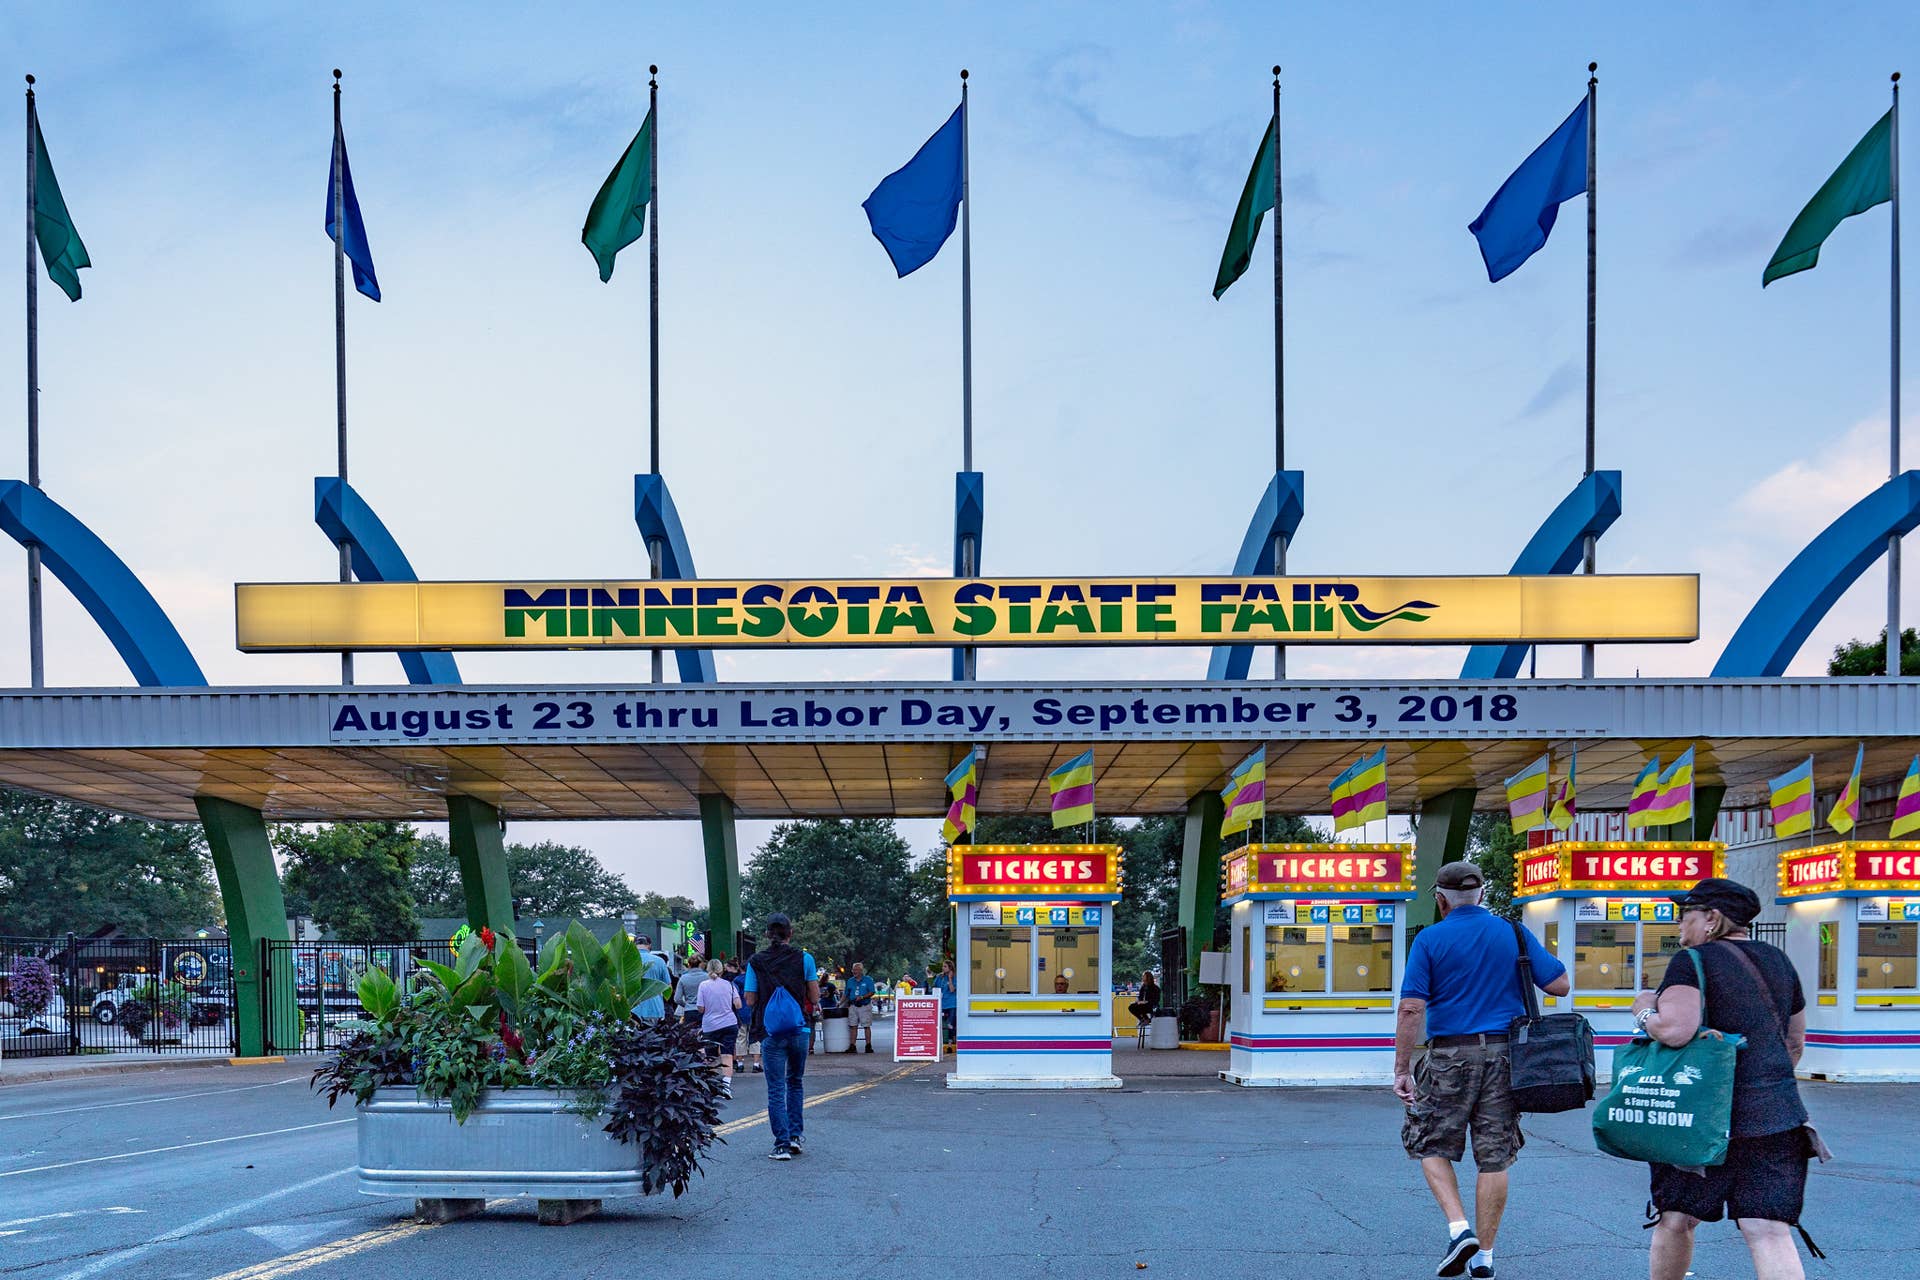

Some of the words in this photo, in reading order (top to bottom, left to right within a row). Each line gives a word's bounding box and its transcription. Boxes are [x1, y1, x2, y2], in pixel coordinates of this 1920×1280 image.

[504, 584, 935, 637] MINNESOTA
[953, 582, 1177, 636] STATE
[1201, 582, 1439, 633] FAIR
[332, 702, 512, 738] August
[532, 701, 595, 730] 23
[613, 701, 718, 730] thru
[740, 700, 888, 728] Labor
[901, 698, 1010, 733] Day,
[1032, 696, 1316, 733] September
[1334, 695, 1377, 728] 3,
[1397, 694, 1518, 723] 2018
[977, 860, 1093, 880] TICKETS
[1272, 858, 1388, 879] TICKETS
[1525, 859, 1560, 883] TICKETS
[1585, 856, 1699, 876] TICKETS
[1792, 858, 1838, 883] TICKETS
[1018, 910, 1034, 921] 14
[1051, 910, 1067, 921] 12
[1084, 910, 1100, 921] 12
[1312, 908, 1328, 919] 14
[1345, 908, 1361, 919] 12
[1378, 908, 1394, 919] 12
[1624, 906, 1639, 917] 14
[1656, 906, 1671, 917] 12
[1905, 905, 1920, 916] 14
[1622, 1085, 1659, 1096] Business
[1660, 1087, 1681, 1098] Expo
[1624, 1097, 1631, 1106] &
[1631, 1097, 1650, 1107] Fare
[1650, 1098, 1676, 1109] Foods
[1608, 1107, 1645, 1124] FOOD
[1647, 1110, 1695, 1128] SHOW
